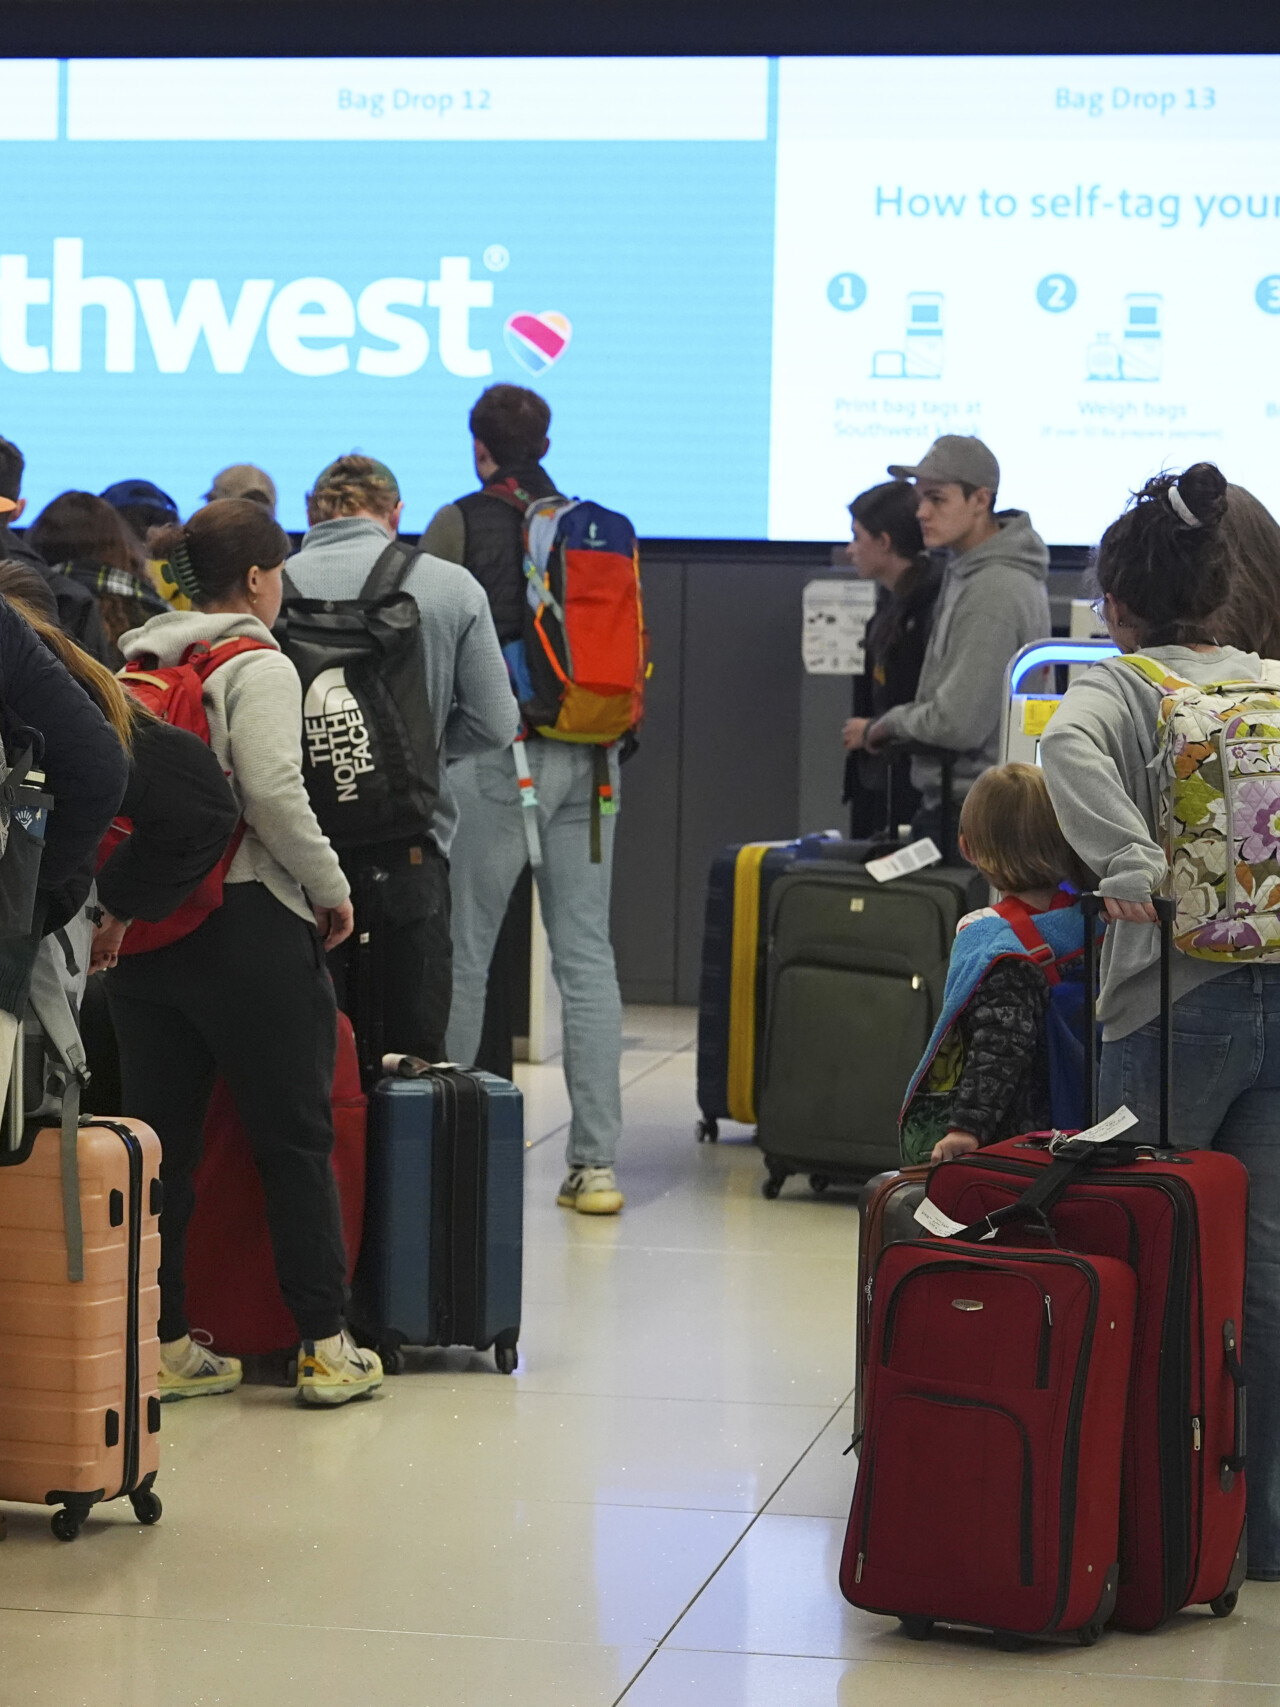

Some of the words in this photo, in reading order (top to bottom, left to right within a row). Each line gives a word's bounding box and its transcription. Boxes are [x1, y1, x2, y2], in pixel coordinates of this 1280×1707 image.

[338, 88, 385, 118] Bag
[393, 88, 454, 117] Drop
[463, 89, 491, 110] 12
[1055, 87, 1104, 117] Bag
[1111, 87, 1177, 116] Drop
[1185, 86, 1217, 110] 13
[874, 184, 968, 219] How
[977, 188, 1019, 219] to
[1029, 183, 1181, 230] self-tag
[837, 276, 856, 306] 1
[1046, 278, 1068, 308] 2
[1077, 400, 1138, 421] Weigh
[1143, 400, 1188, 423] bags
[304, 717, 331, 768] THE
[344, 709, 376, 775] FACE
[326, 713, 359, 803] NORTH
